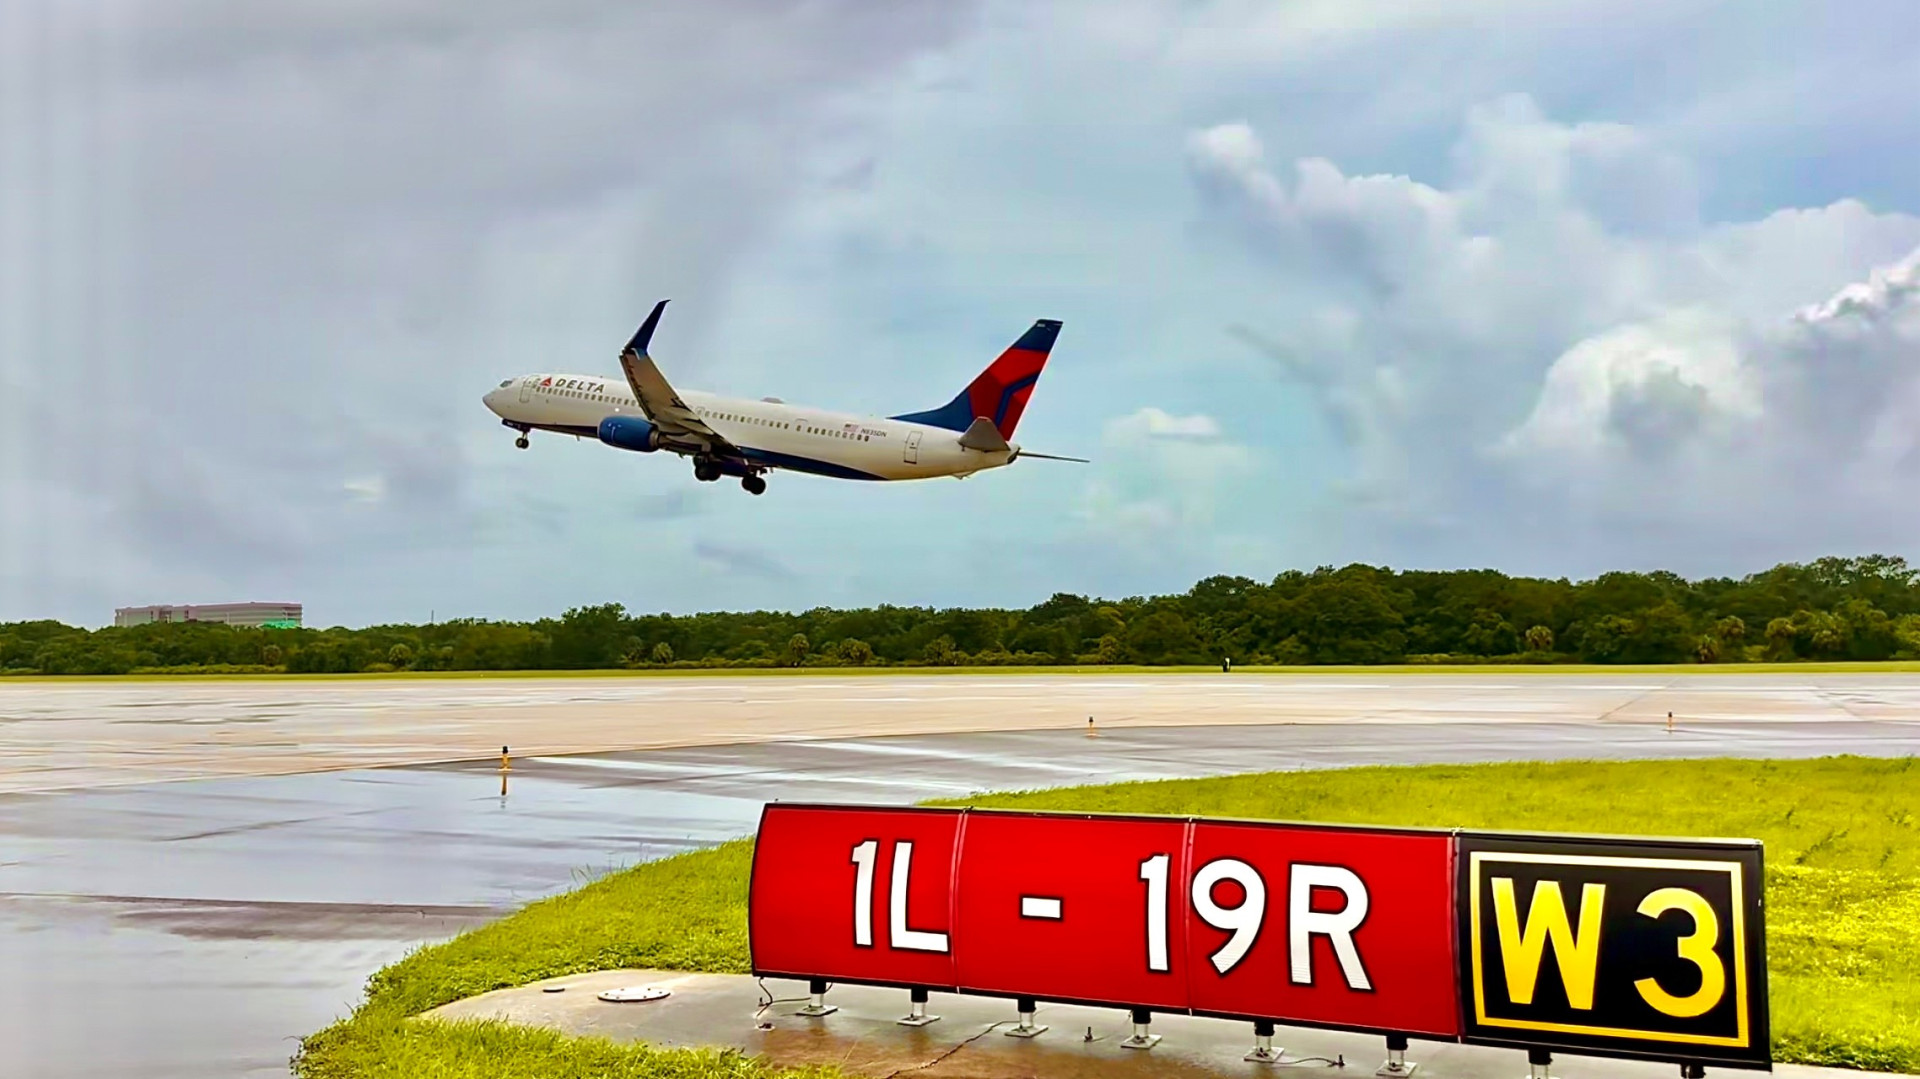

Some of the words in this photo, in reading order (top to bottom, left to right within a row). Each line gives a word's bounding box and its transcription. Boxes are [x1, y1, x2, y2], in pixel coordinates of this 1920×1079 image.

[555, 378, 605, 393] DELTA
[850, 840, 949, 953] 1L
[1021, 897, 1061, 919] -
[1139, 854, 1370, 991] 19R
